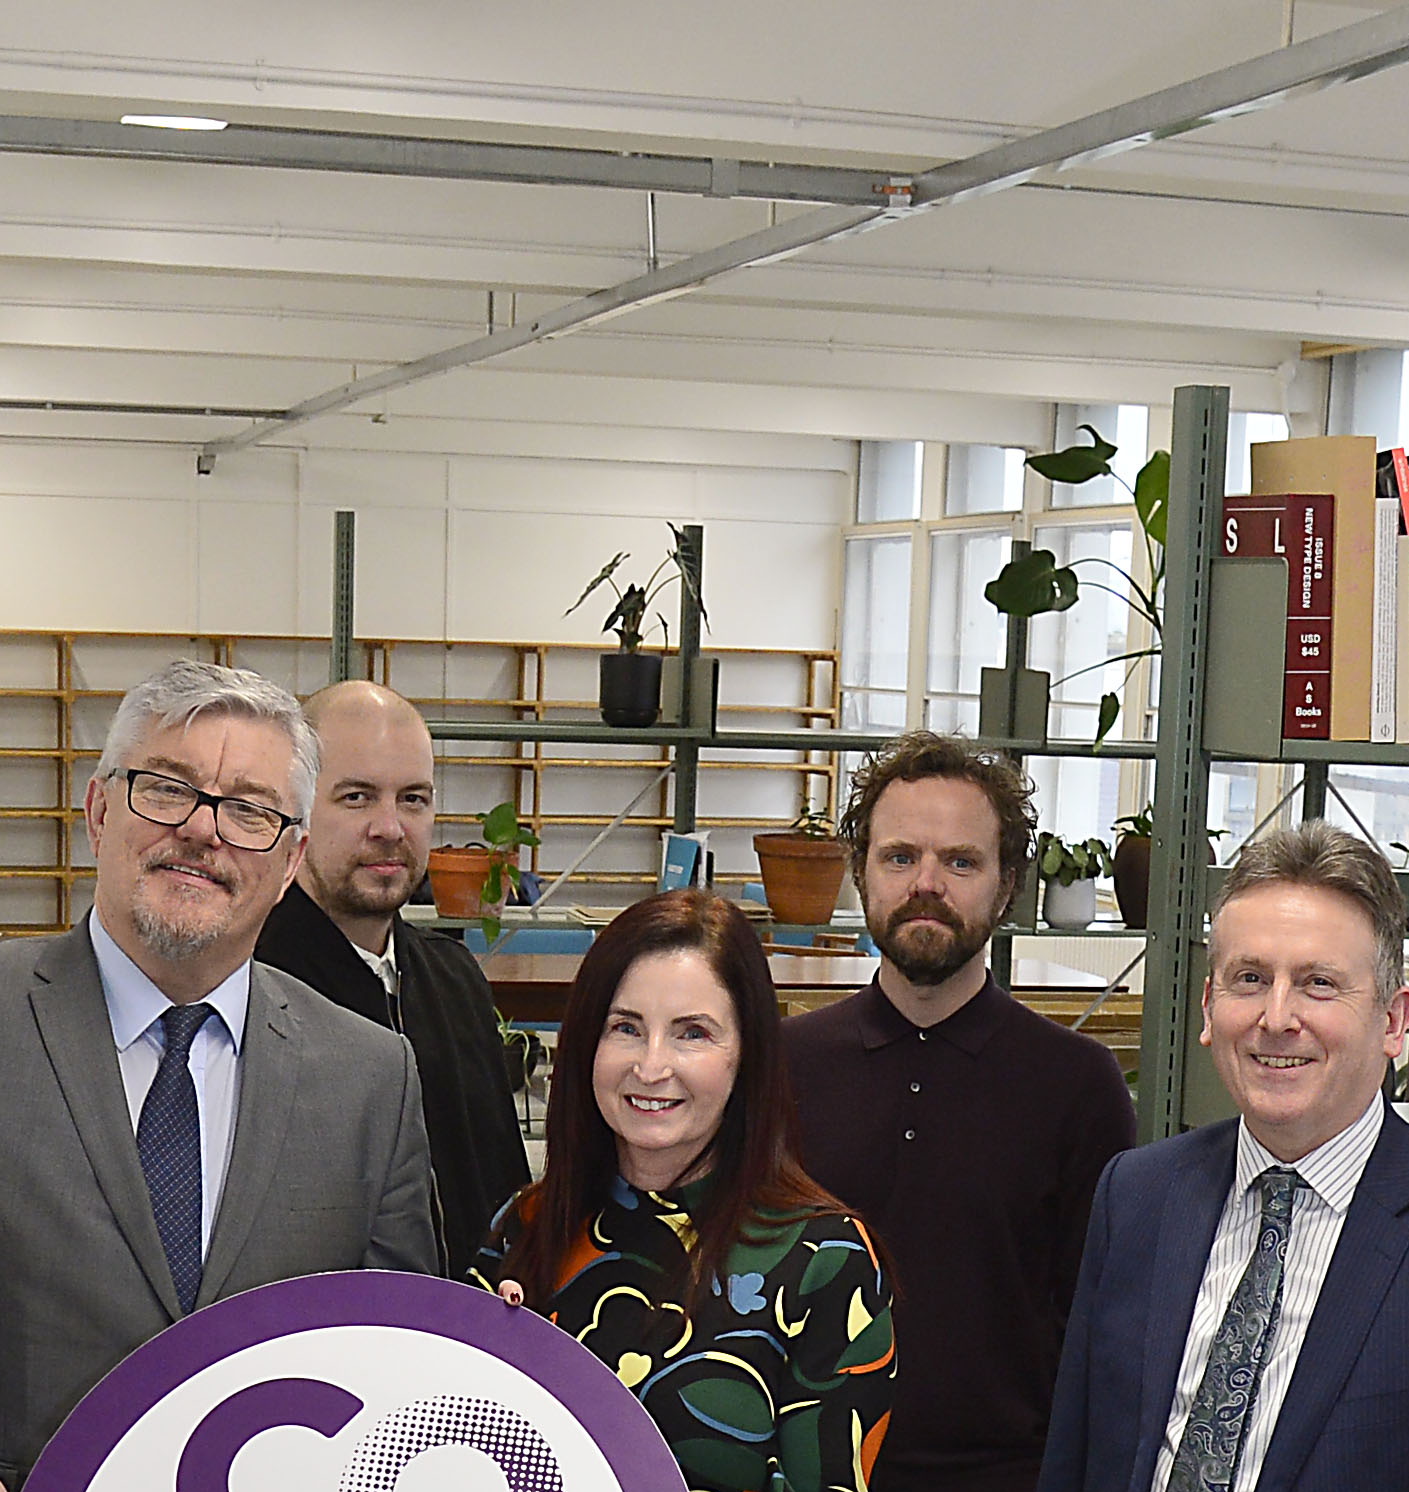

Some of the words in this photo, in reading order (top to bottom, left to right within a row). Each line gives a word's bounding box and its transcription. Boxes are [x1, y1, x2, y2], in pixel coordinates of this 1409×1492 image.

[1304, 507, 1314, 534] NEW
[1225, 517, 1238, 553] S
[1274, 517, 1285, 553] L
[1303, 535, 1313, 564] TYPE
[1302, 566, 1312, 609] DESIGN
[1300, 634, 1321, 644] USD
[1295, 706, 1322, 717] Books
